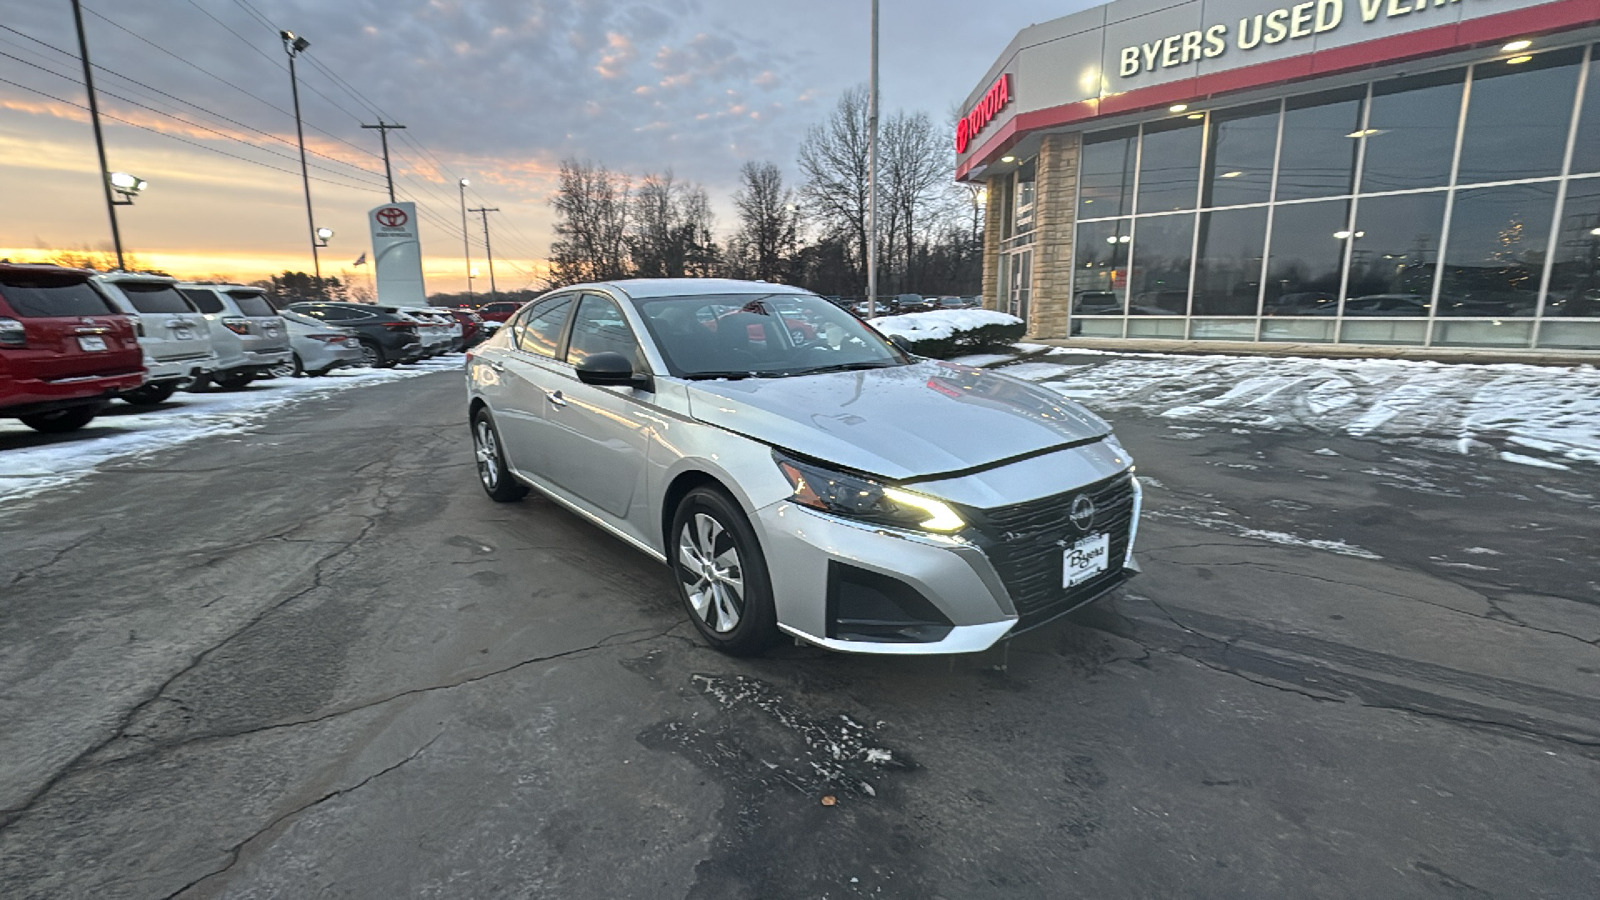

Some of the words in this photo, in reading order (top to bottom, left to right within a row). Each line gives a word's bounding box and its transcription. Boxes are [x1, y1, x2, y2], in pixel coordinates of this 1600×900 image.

[1119, 24, 1227, 77] BYERS
[1237, 0, 1344, 49] USED
[968, 74, 1008, 139] TOYOTA
[1066, 546, 1105, 569] Byers
